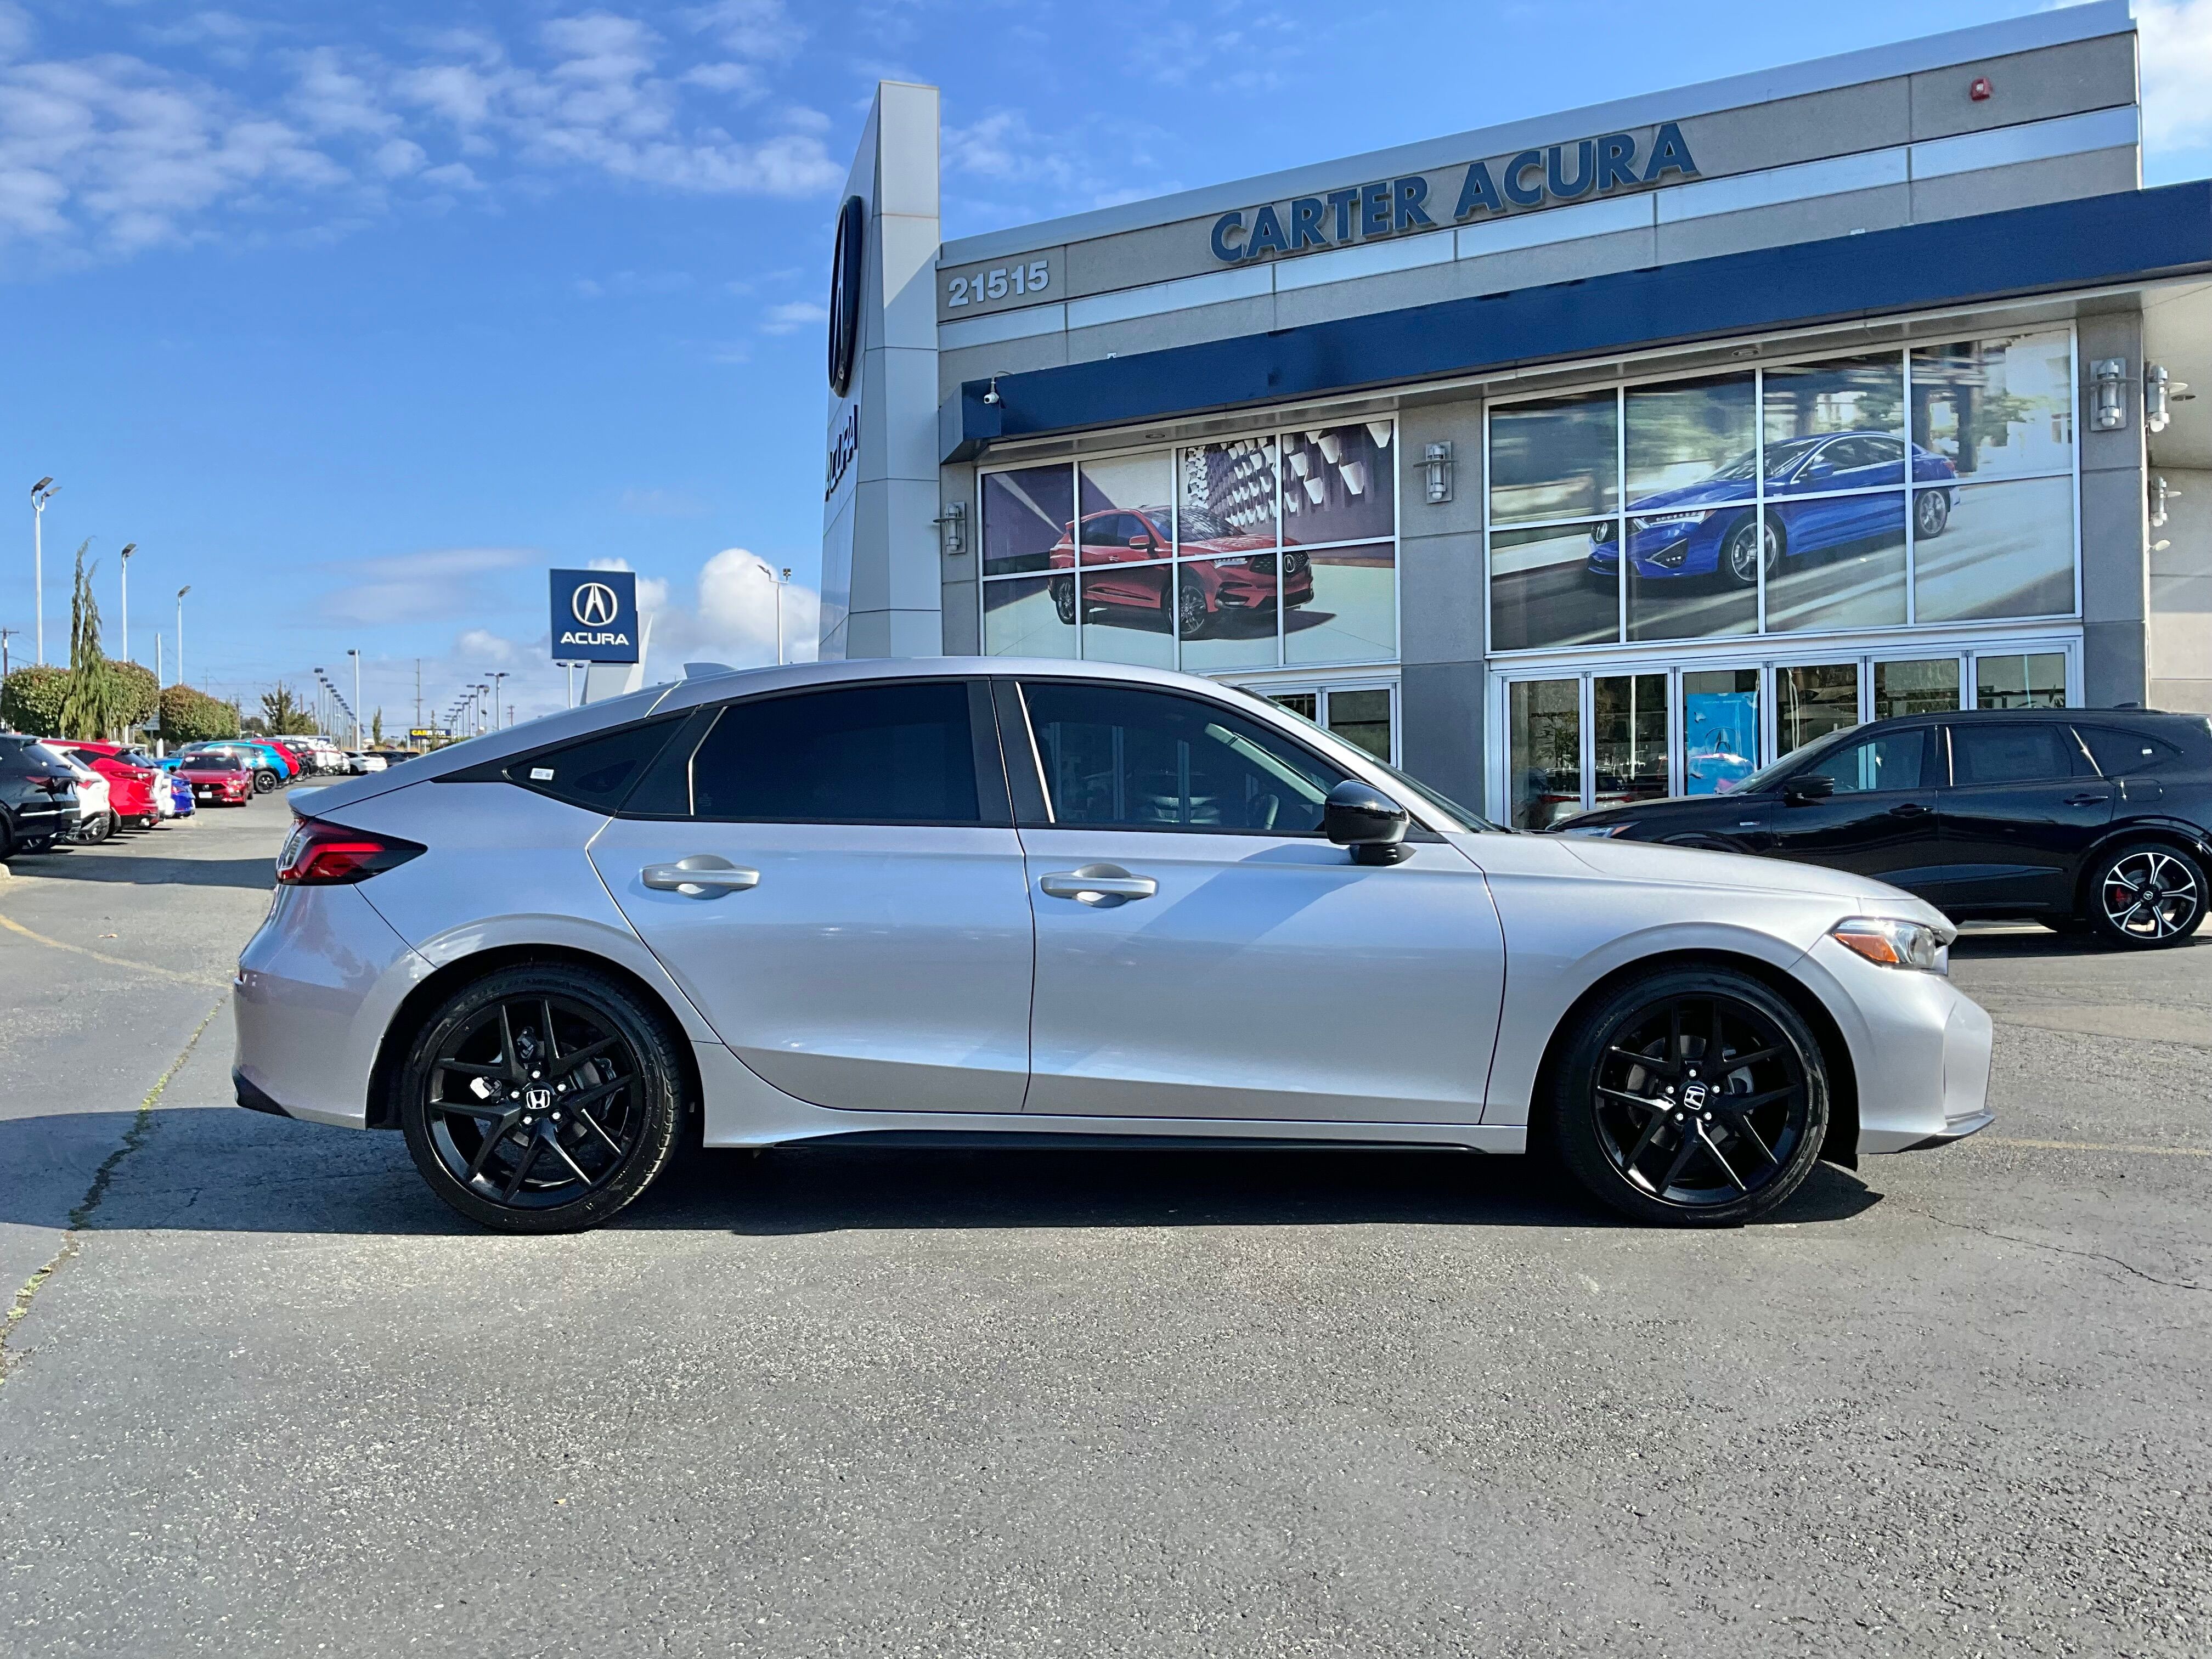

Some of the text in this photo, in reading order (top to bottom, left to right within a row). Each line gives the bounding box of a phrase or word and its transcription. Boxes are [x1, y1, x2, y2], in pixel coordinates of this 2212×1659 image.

[1210, 121, 1699, 262] CARTER ACURA
[949, 259, 1049, 308] 21515
[560, 631, 629, 645] ACURA
